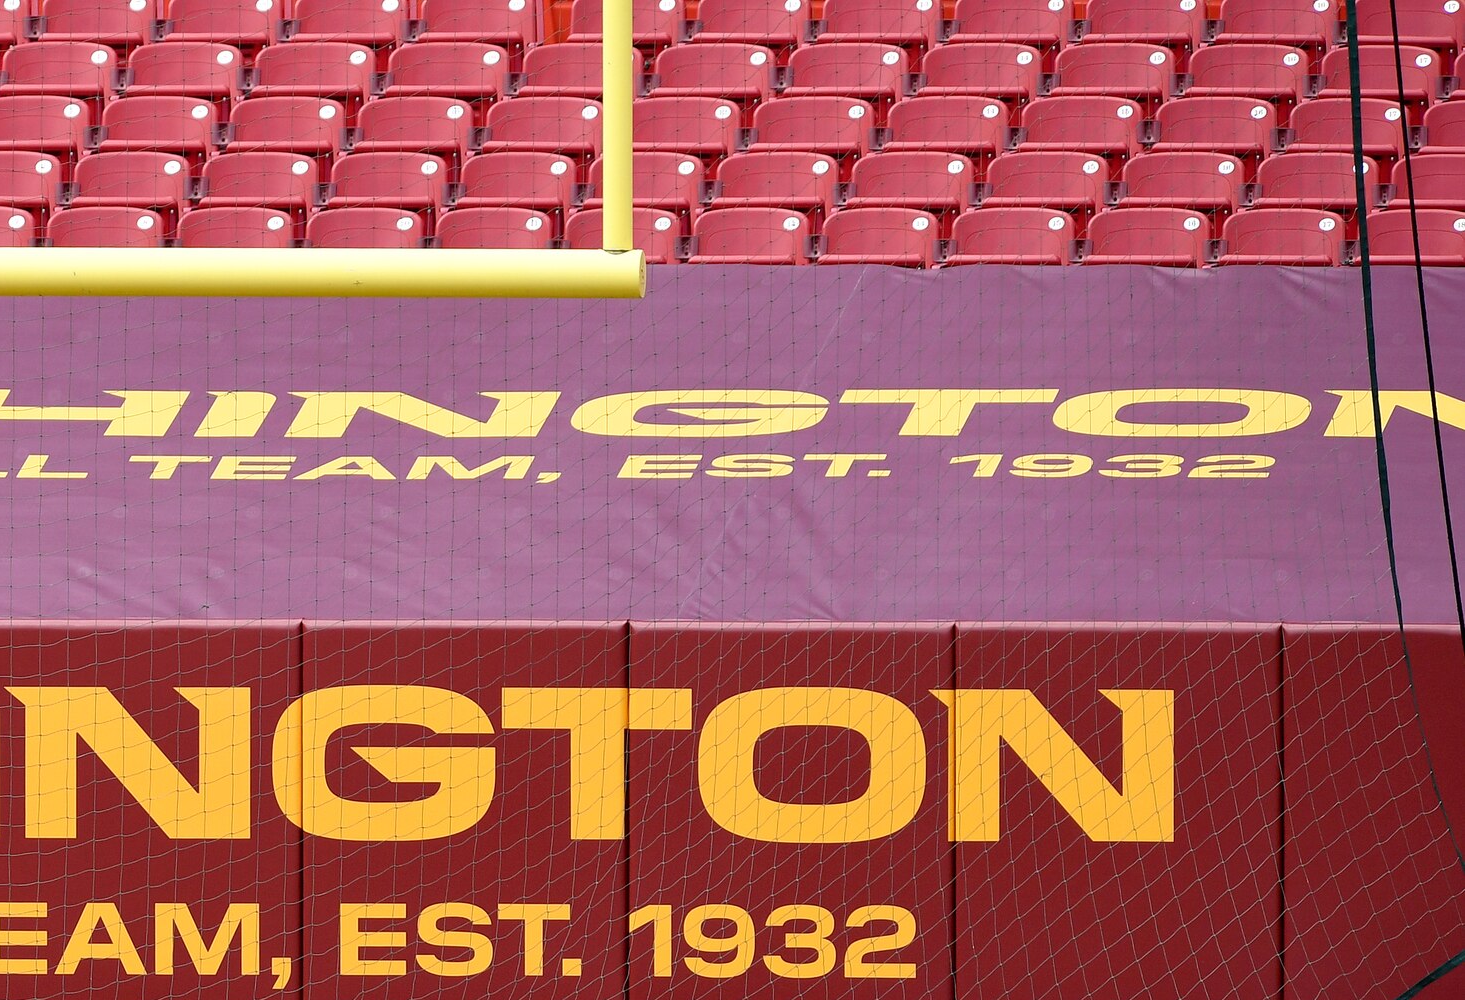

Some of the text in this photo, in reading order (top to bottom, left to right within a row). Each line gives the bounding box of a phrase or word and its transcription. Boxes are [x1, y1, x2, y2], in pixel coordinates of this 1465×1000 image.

[128, 454, 562, 484] TEAM,
[617, 453, 891, 479] EST.
[948, 453, 1277, 479] 1932
[339, 903, 582, 978] EST.
[627, 903, 918, 979] 1932
